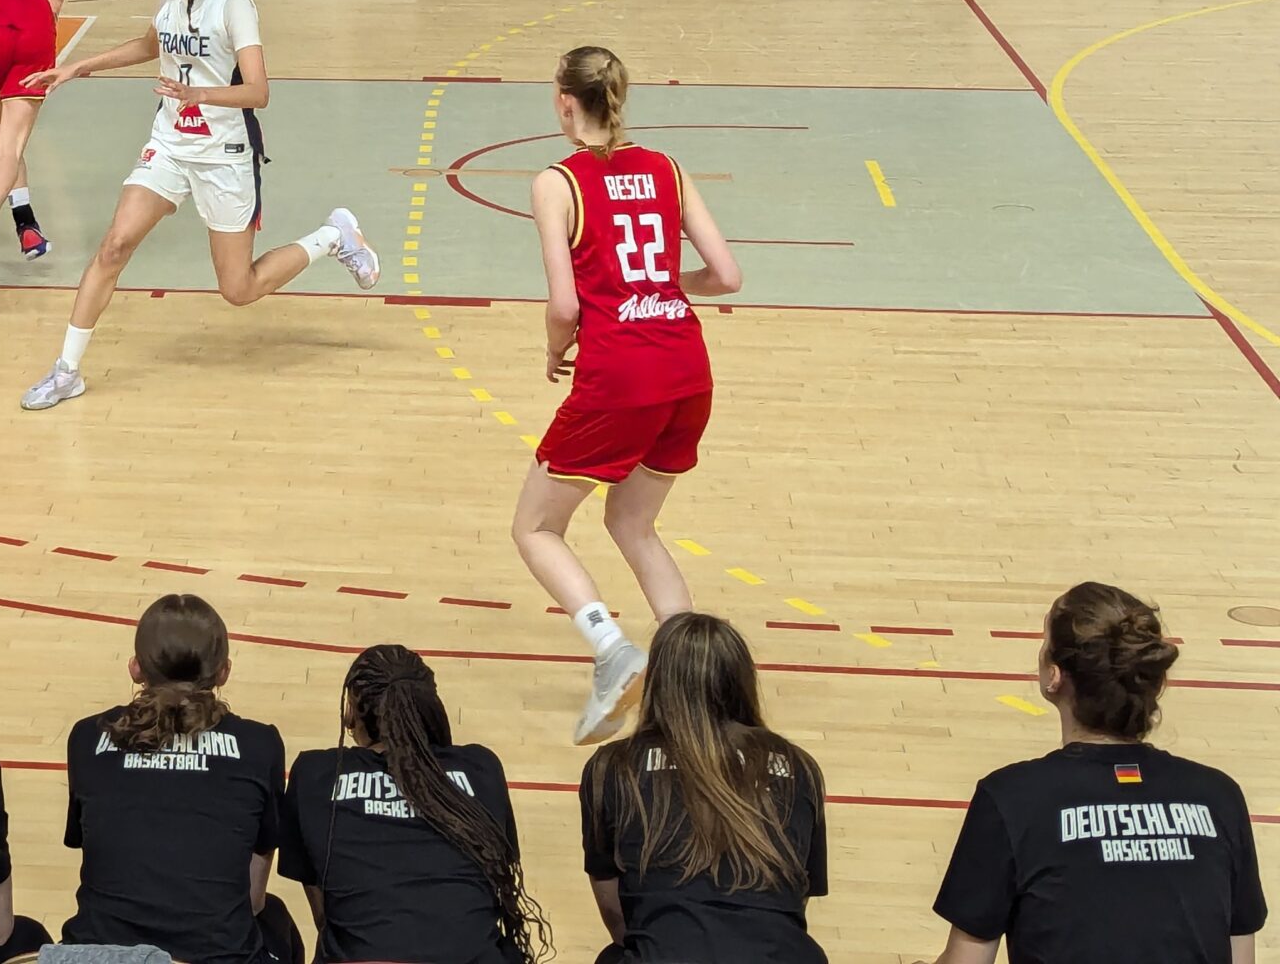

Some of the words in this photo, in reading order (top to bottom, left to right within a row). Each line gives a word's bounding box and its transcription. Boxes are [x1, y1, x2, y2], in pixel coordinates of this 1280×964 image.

[159, 32, 211, 57] FRANCE
[603, 173, 657, 200] BESCH
[613, 213, 670, 283] 22
[123, 752, 210, 772] BASKETBALL
[1061, 803, 1218, 842] DEUTSCHLAND
[1101, 838, 1195, 862] BASKETBALL
